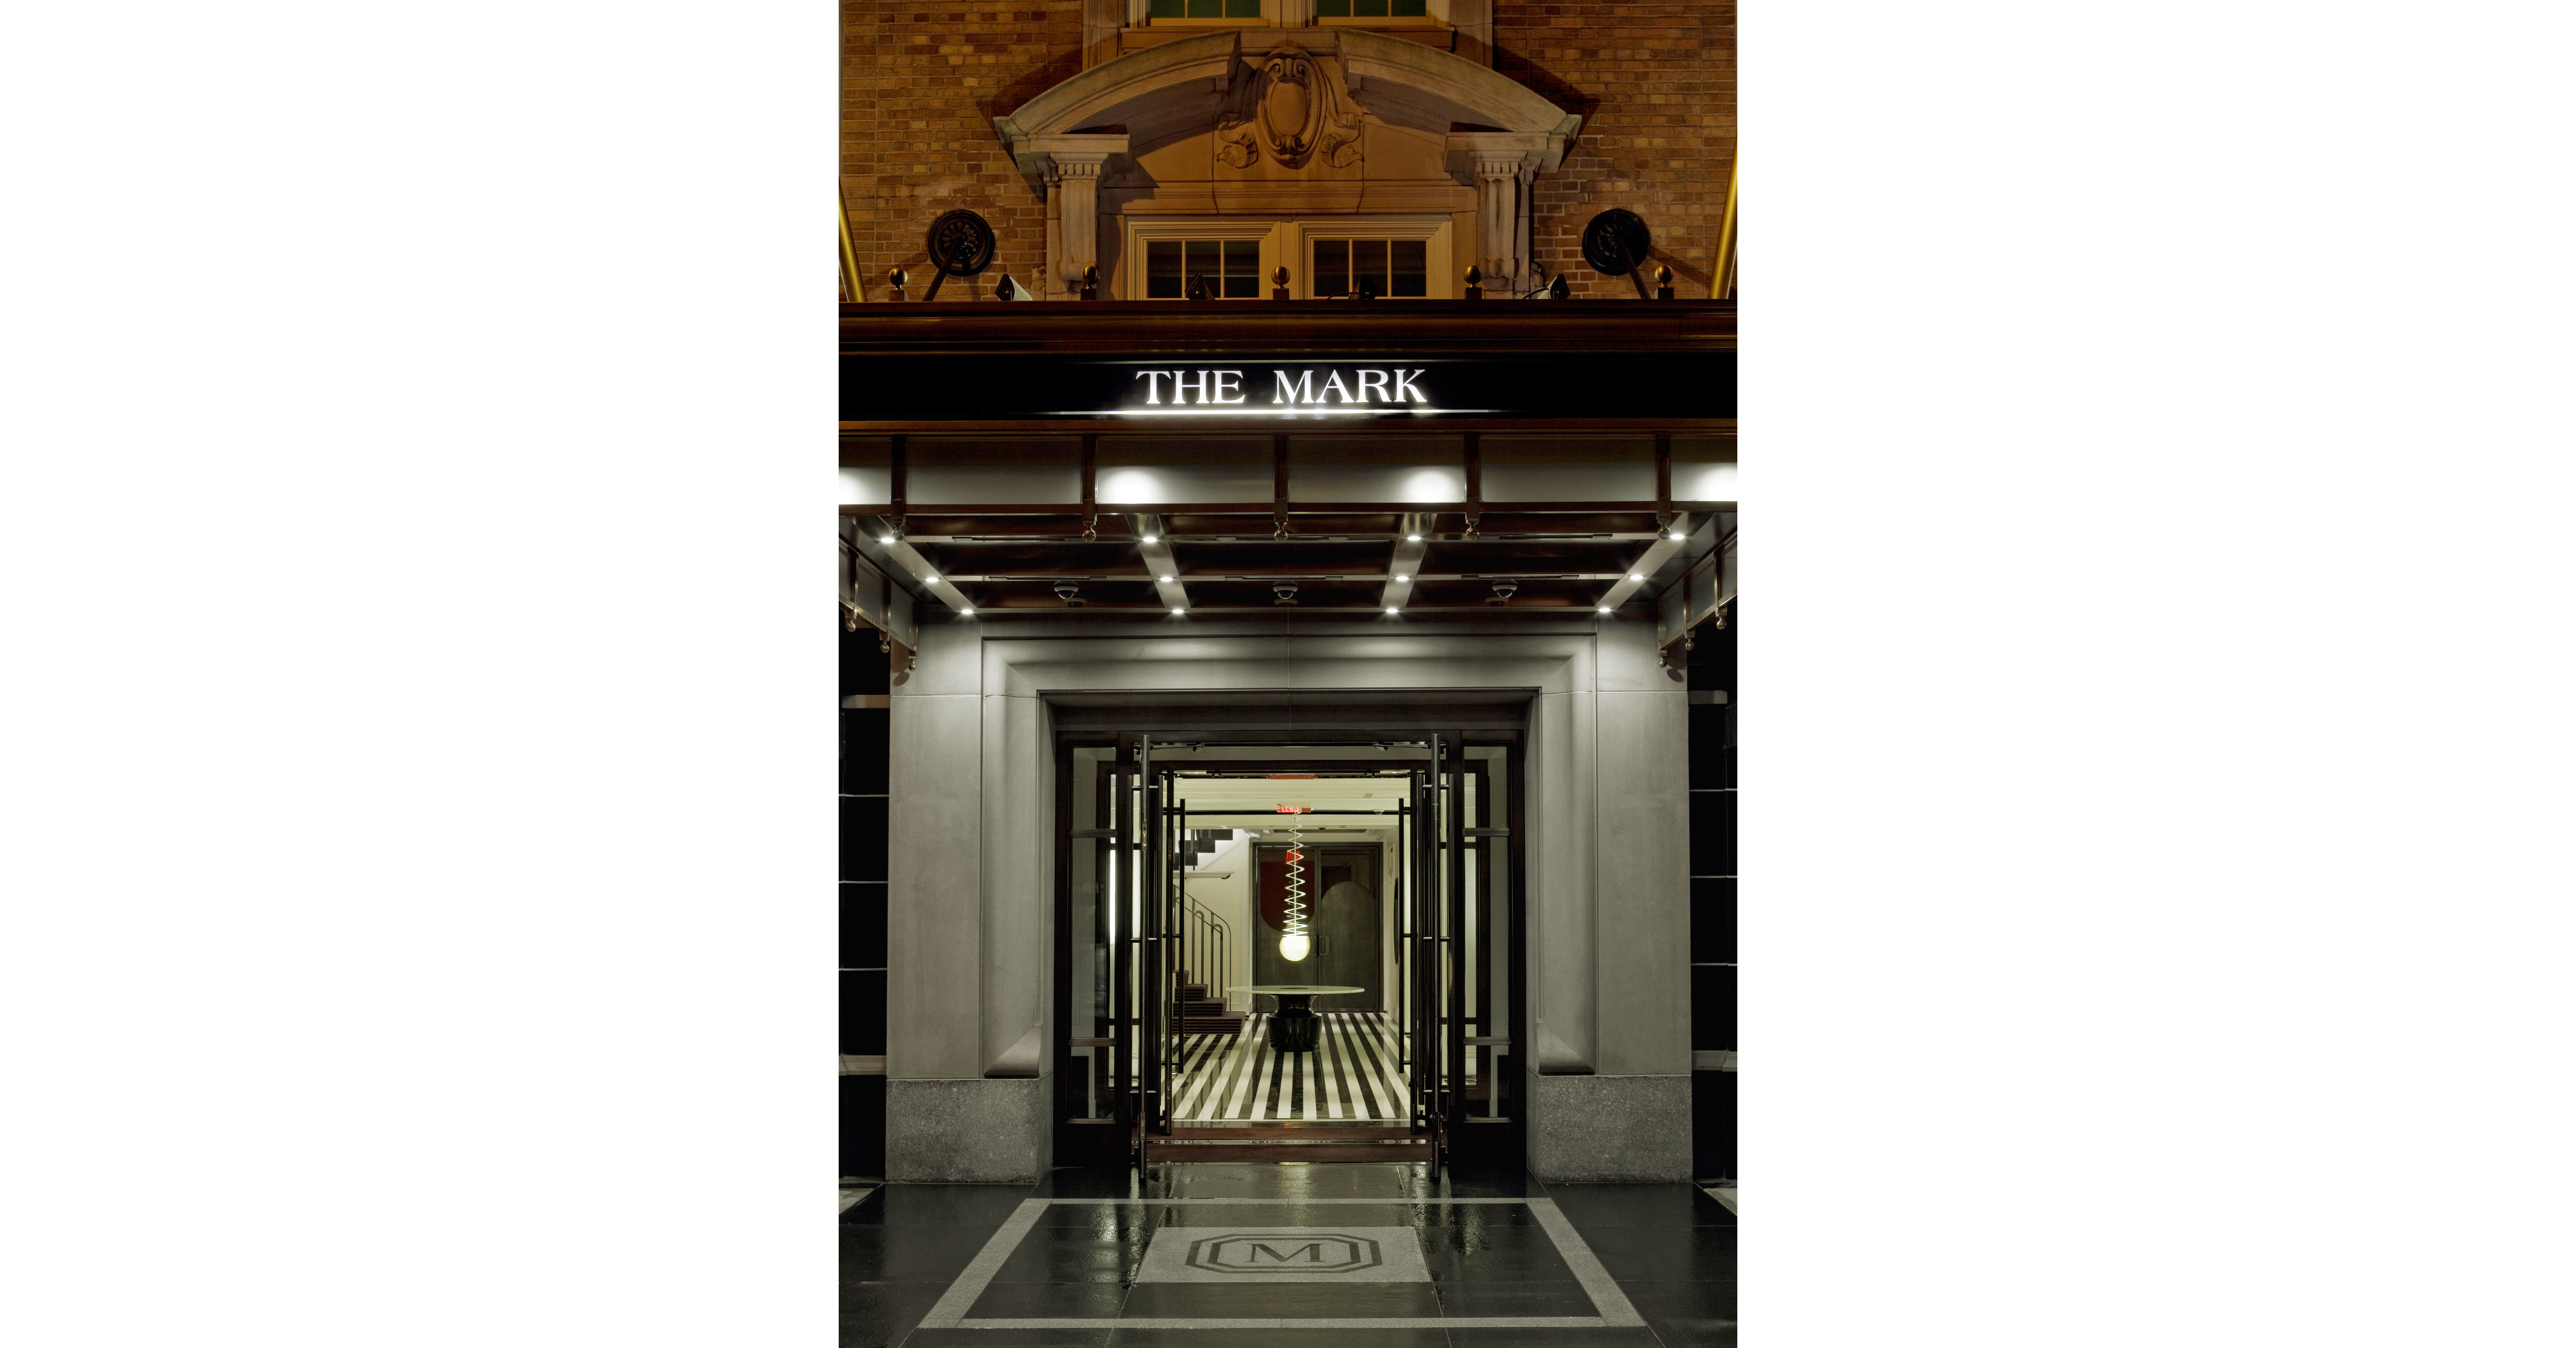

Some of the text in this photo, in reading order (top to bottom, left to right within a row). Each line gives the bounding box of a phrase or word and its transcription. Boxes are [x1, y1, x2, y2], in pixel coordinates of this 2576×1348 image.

[1135, 369, 1427, 404] THE MARK
[1245, 1243, 1326, 1262] M
